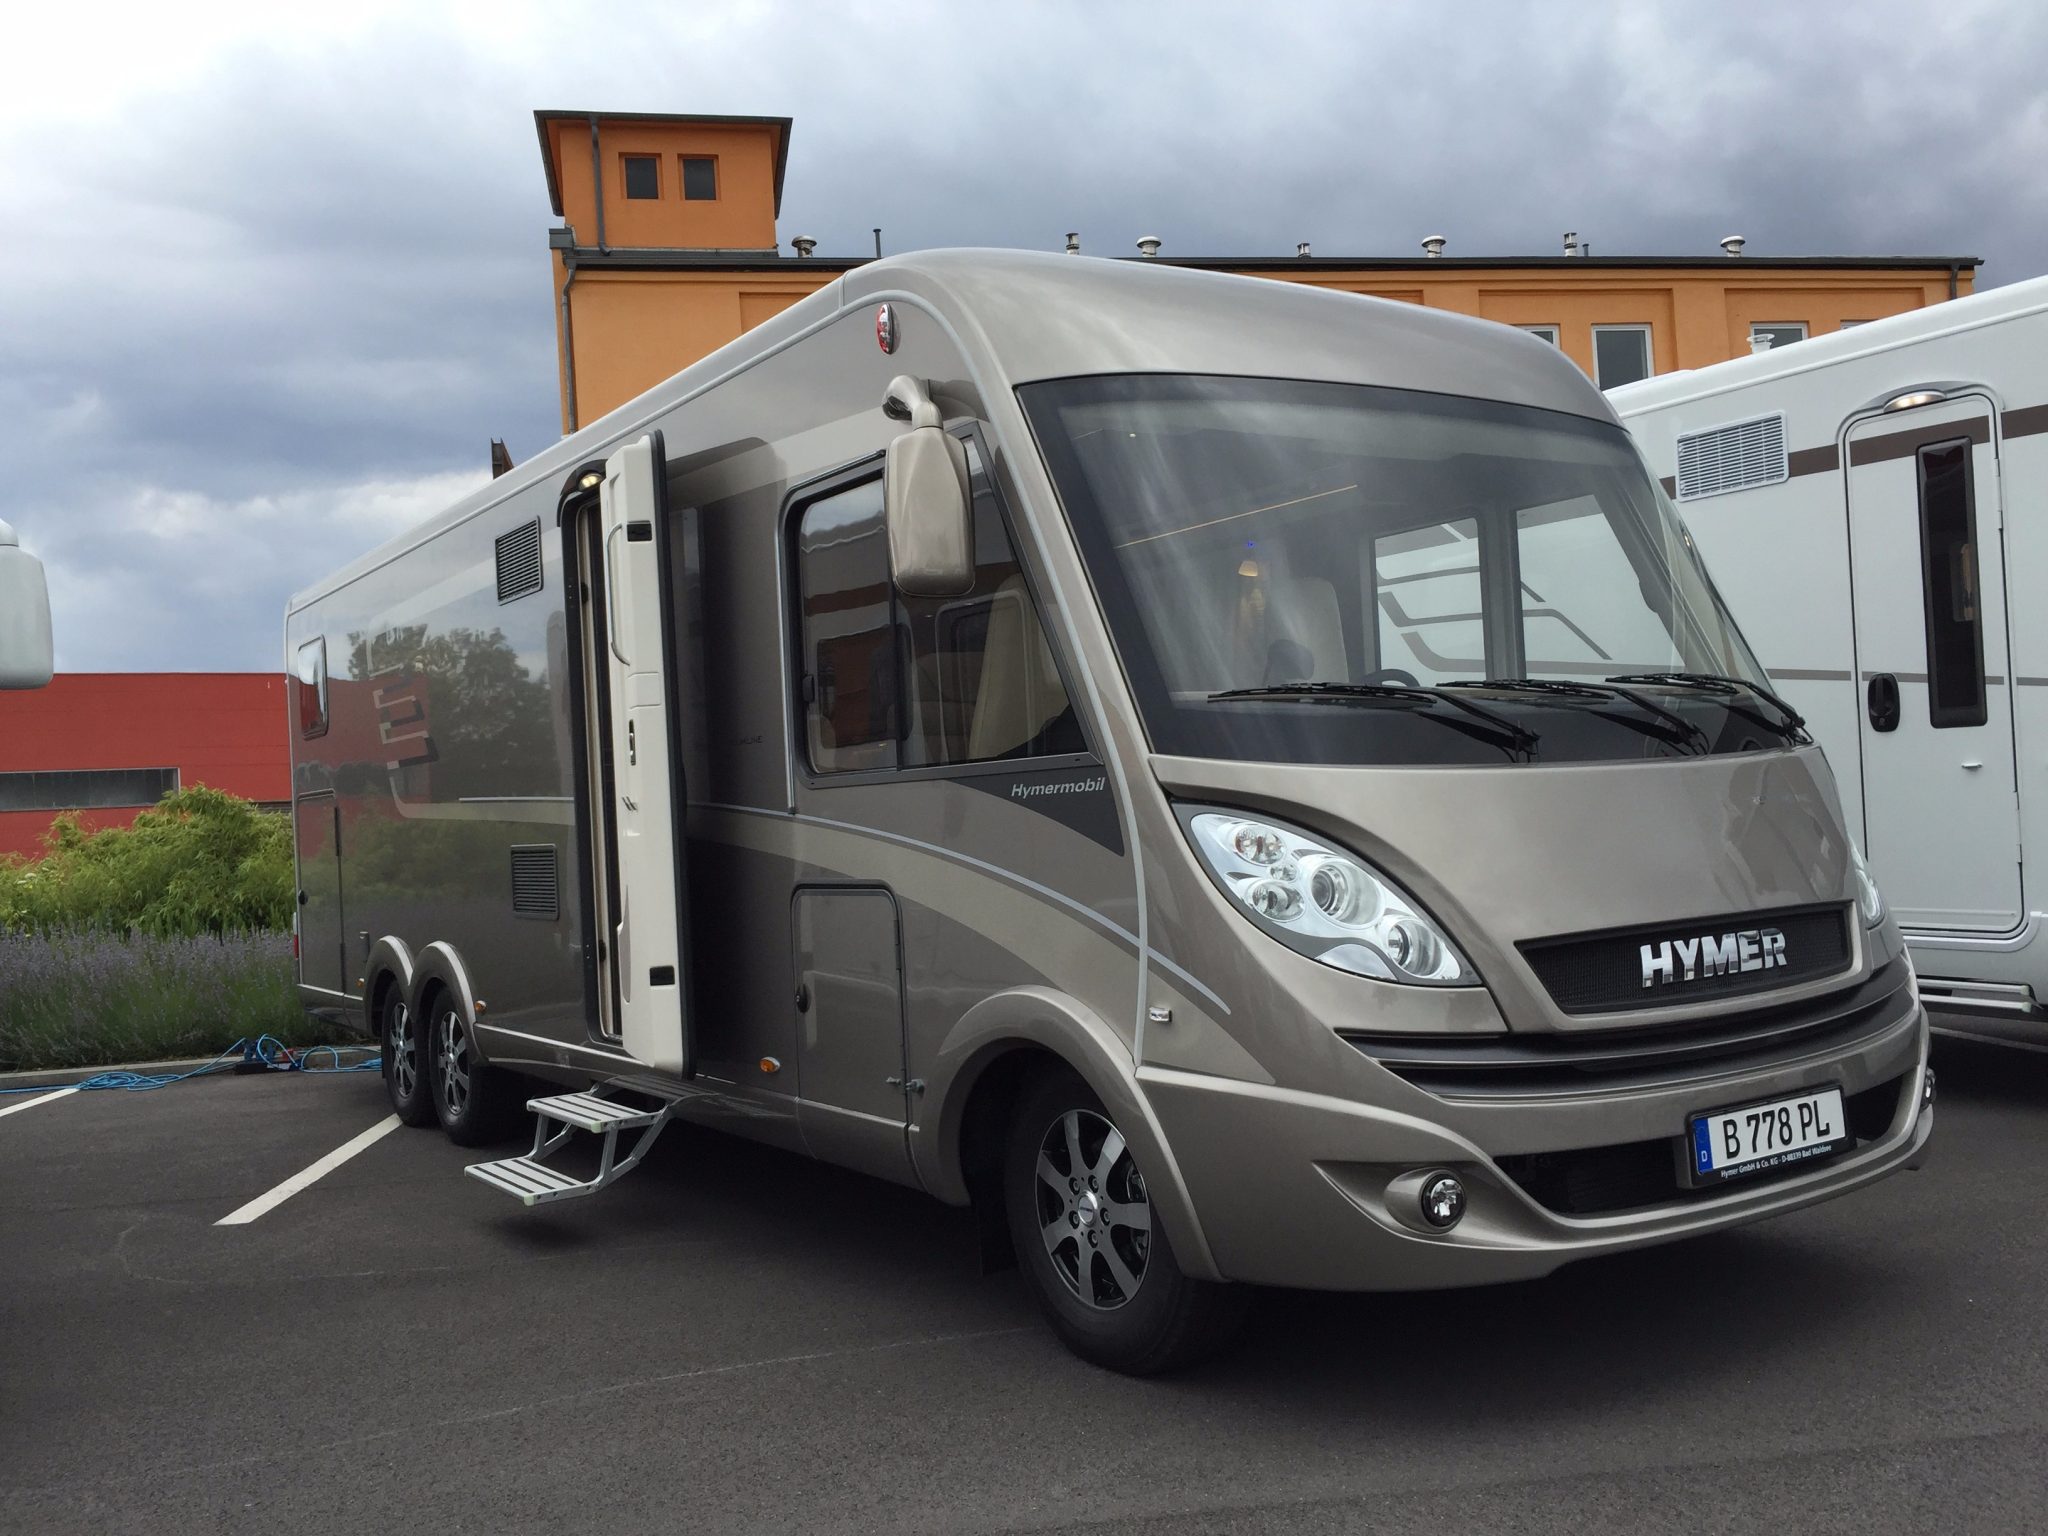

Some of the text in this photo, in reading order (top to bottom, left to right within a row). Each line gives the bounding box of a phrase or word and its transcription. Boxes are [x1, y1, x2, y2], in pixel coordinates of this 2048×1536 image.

[1011, 777, 1106, 799] Hymermobil
[1639, 927, 1788, 988] HYMER
[1722, 1100, 1831, 1160] B 778 PL
[1701, 1150, 1708, 1162] D
[1721, 1168, 1738, 1178] Hymer
[1739, 1163, 1756, 1173] GmbH
[1802, 1149, 1811, 1157] Bad
